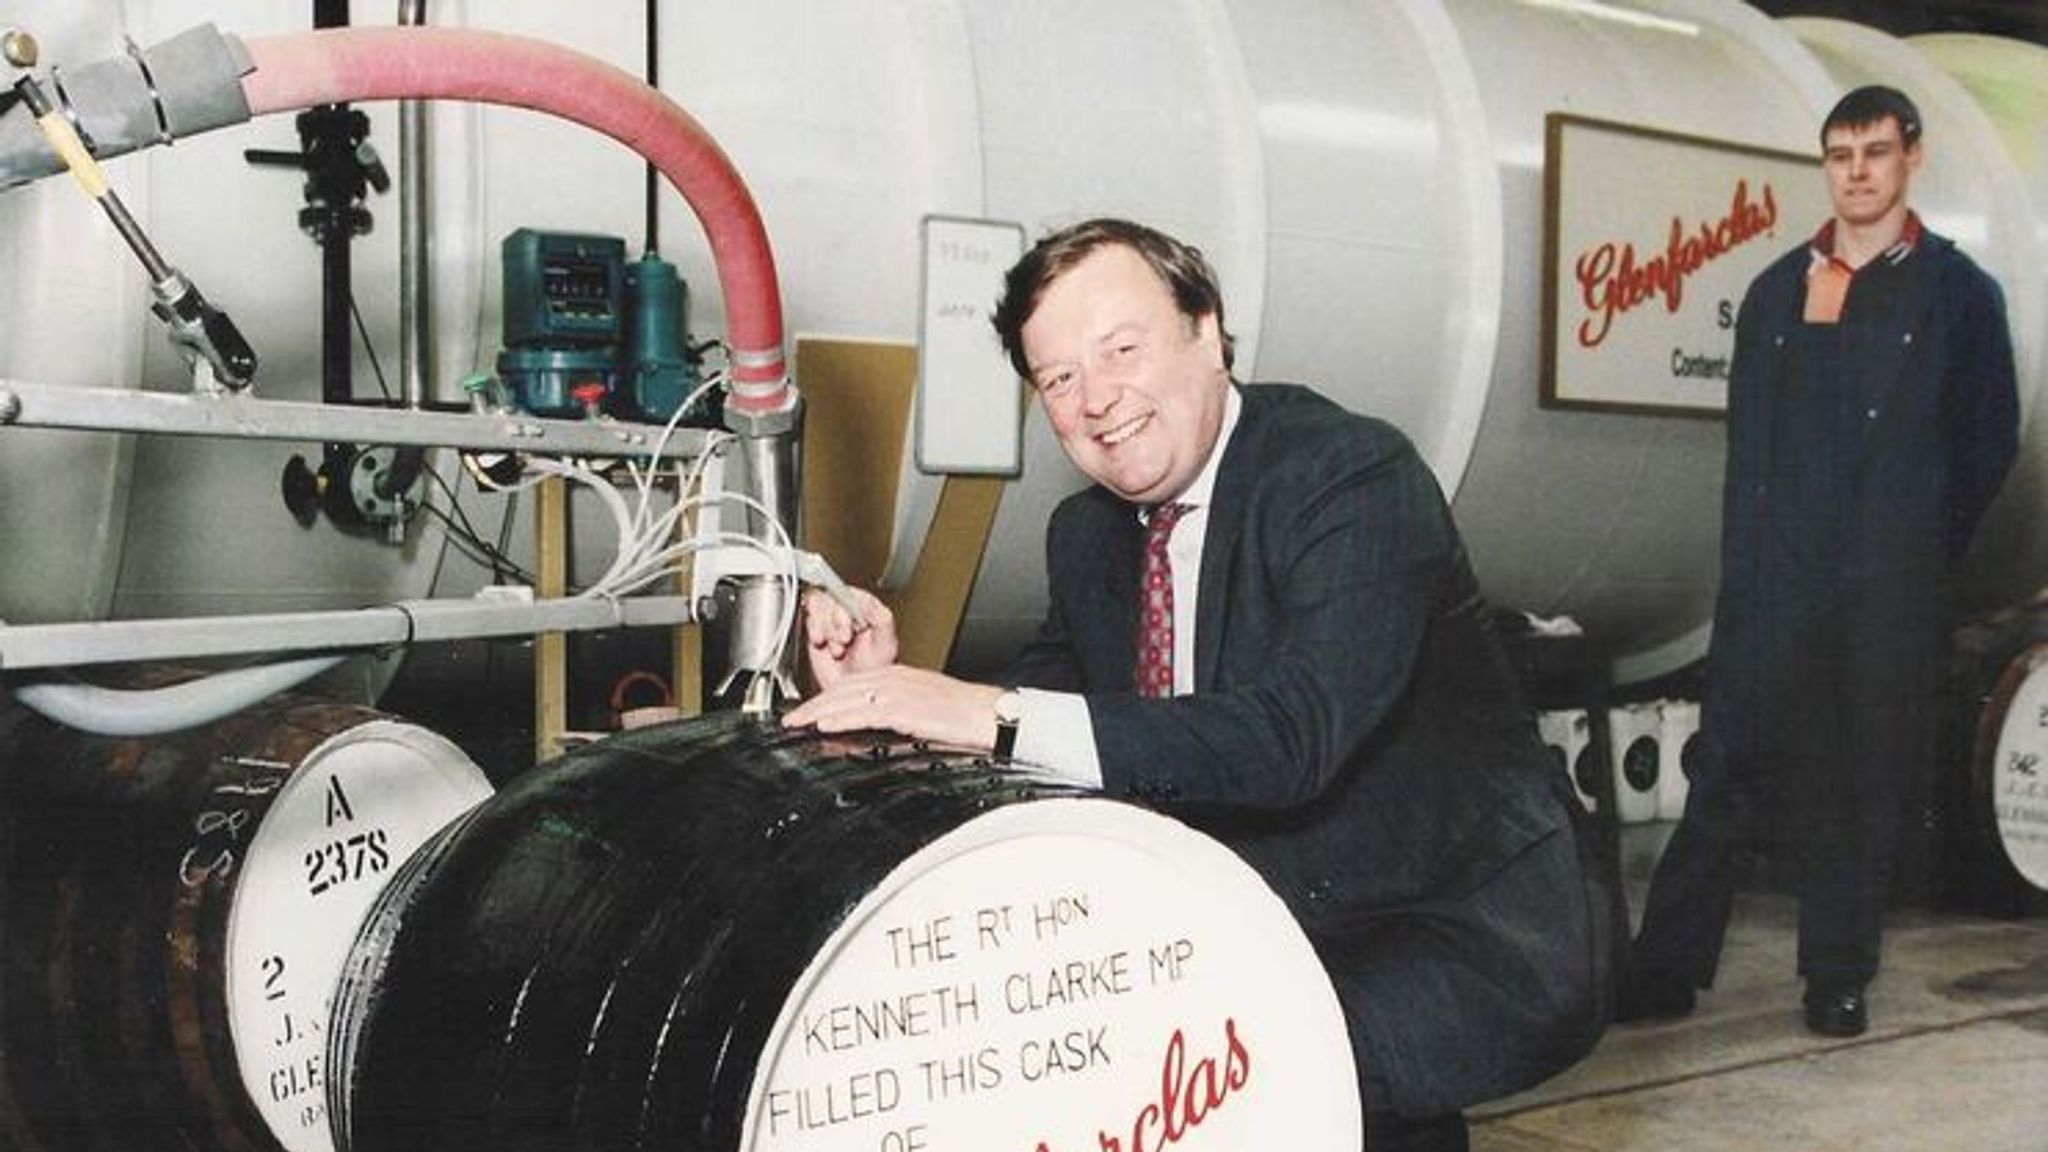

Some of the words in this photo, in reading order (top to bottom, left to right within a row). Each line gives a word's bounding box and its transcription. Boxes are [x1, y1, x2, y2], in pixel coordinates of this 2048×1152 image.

[1576, 177, 1776, 348] Glenfarclas
[326, 773, 354, 828] A
[262, 955, 286, 1001] 2
[886, 915, 957, 969] THE
[803, 981, 980, 1057] KENNETH
[1004, 951, 1133, 1016] CLARKE
[1148, 938, 1195, 986] MP
[768, 1067, 901, 1137] FILLED
[919, 1047, 1004, 1103] THIS
[1020, 1025, 1112, 1081] CASK
